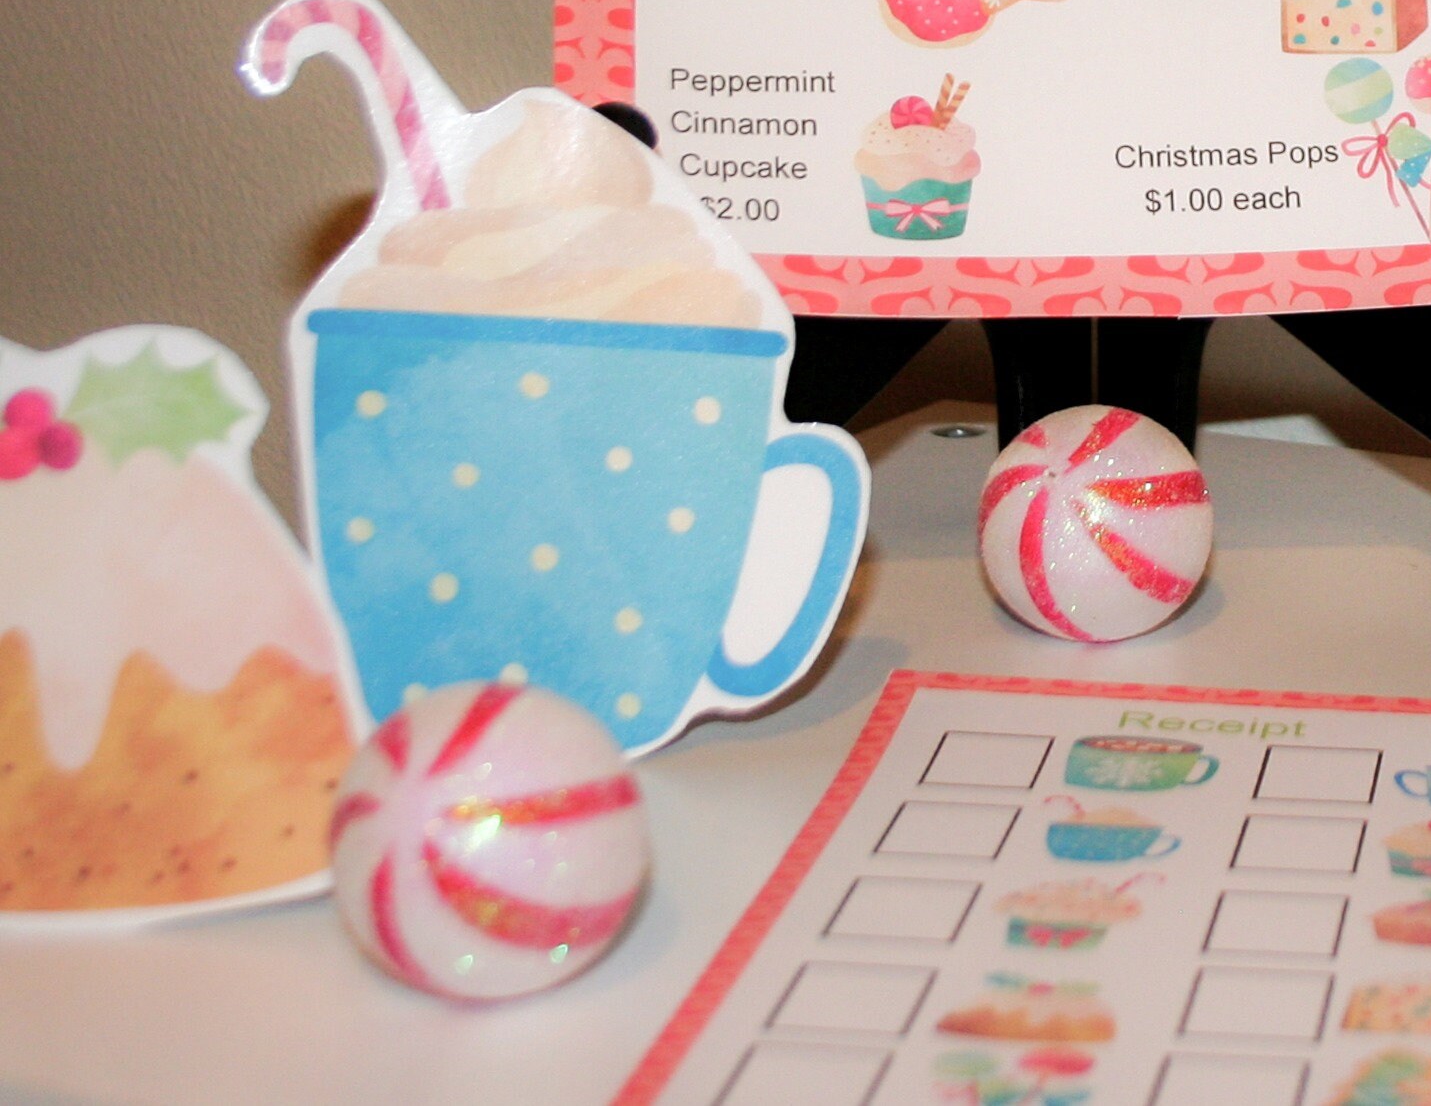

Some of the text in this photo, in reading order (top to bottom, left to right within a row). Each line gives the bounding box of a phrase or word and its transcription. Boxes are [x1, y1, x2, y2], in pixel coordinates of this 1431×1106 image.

[671, 68, 835, 97] Peppermint
[671, 110, 817, 136] Cinnamon
[680, 153, 807, 182] Cupcake
[1115, 141, 1339, 169] Christmas Pops
[1145, 186, 1301, 215] $1.00 each
[1117, 709, 1307, 740] Receipt
